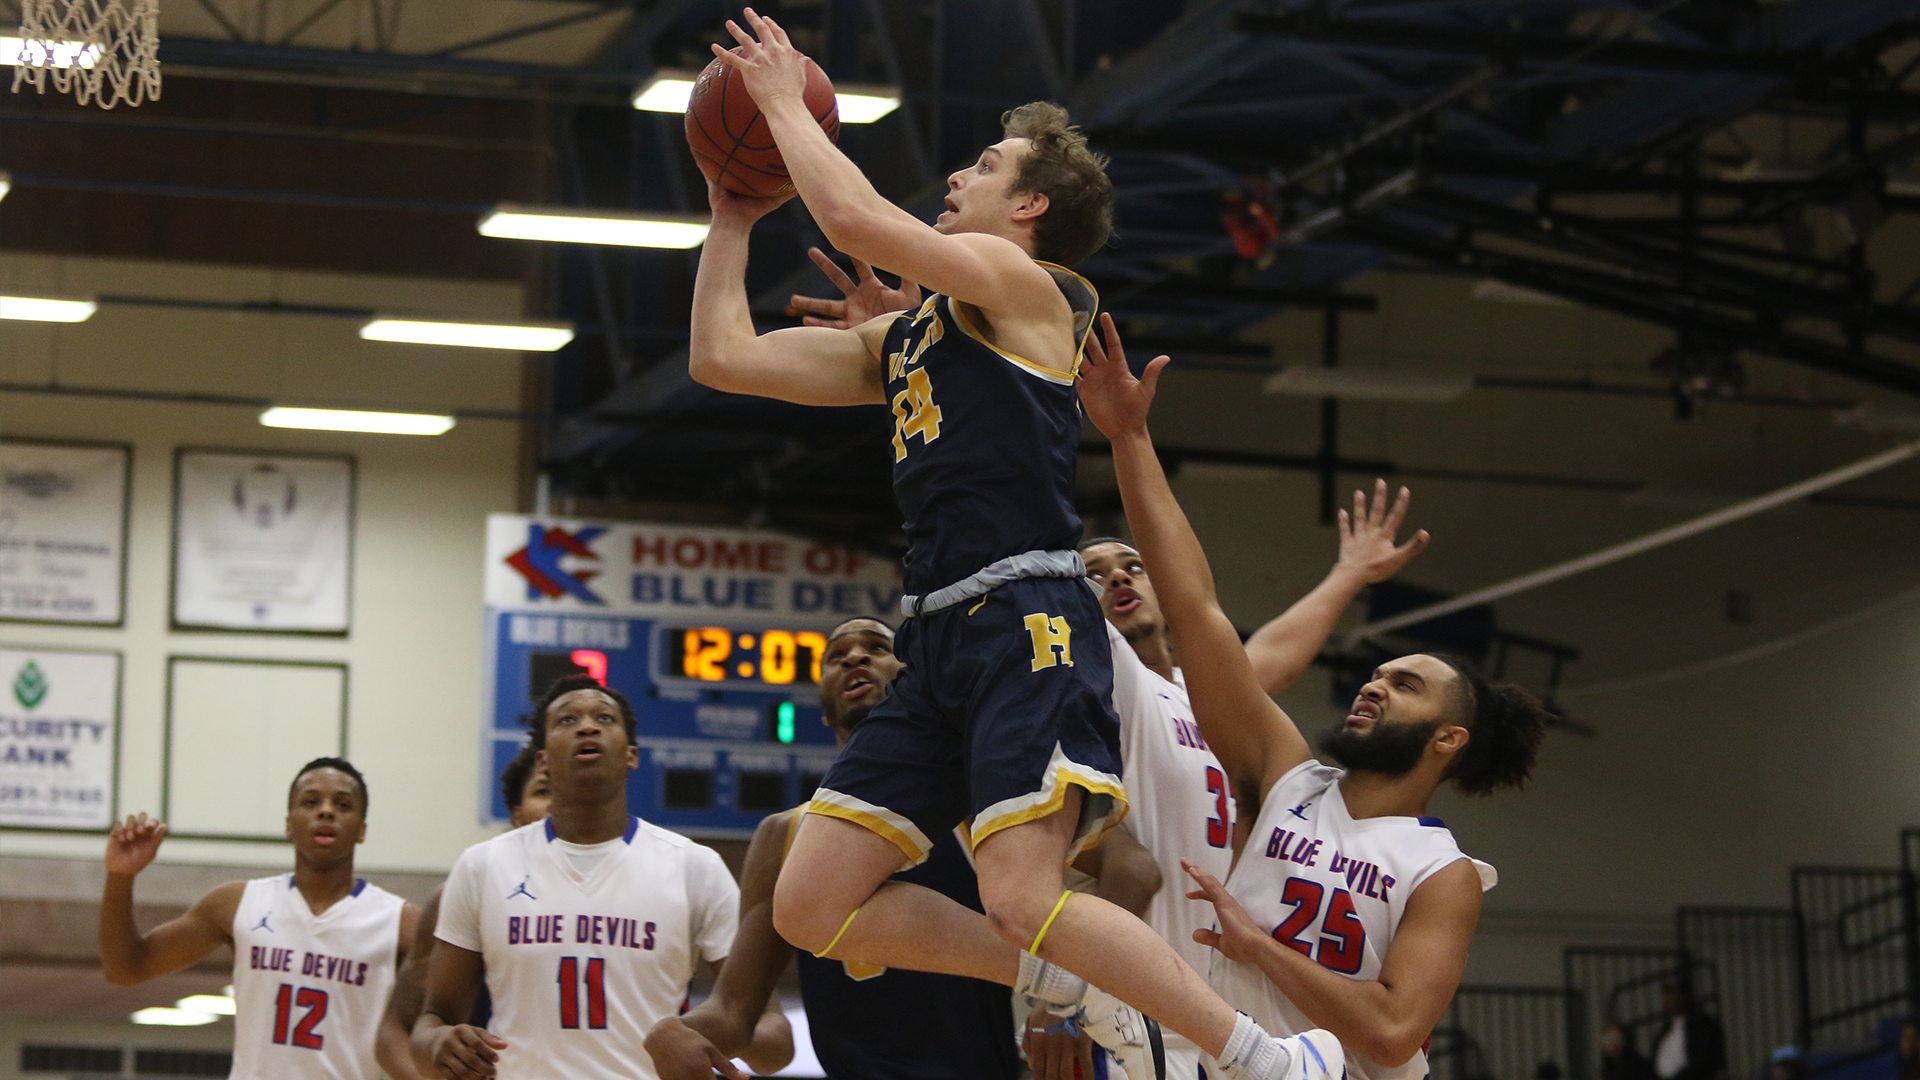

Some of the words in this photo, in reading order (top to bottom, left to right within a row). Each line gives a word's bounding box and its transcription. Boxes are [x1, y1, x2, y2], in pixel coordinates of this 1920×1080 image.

[631, 534, 786, 574] HOME
[803, 545, 870, 579] OF
[631, 574, 776, 609] BLUE
[683, 626, 828, 685] 12:07
[1023, 612, 1074, 673] H
[776, 700, 796, 744] 1
[1205, 764, 1237, 850] 3
[1265, 826, 1324, 868] BLUE
[1328, 849, 1397, 904] DEVILS
[508, 914, 564, 945] BLUE
[575, 914, 658, 951] DEVILS
[1272, 876, 1366, 975] 25
[249, 945, 293, 972] BLUE
[301, 951, 370, 987] DEVILS
[556, 955, 608, 1030] 11
[271, 982, 329, 1051] 12
